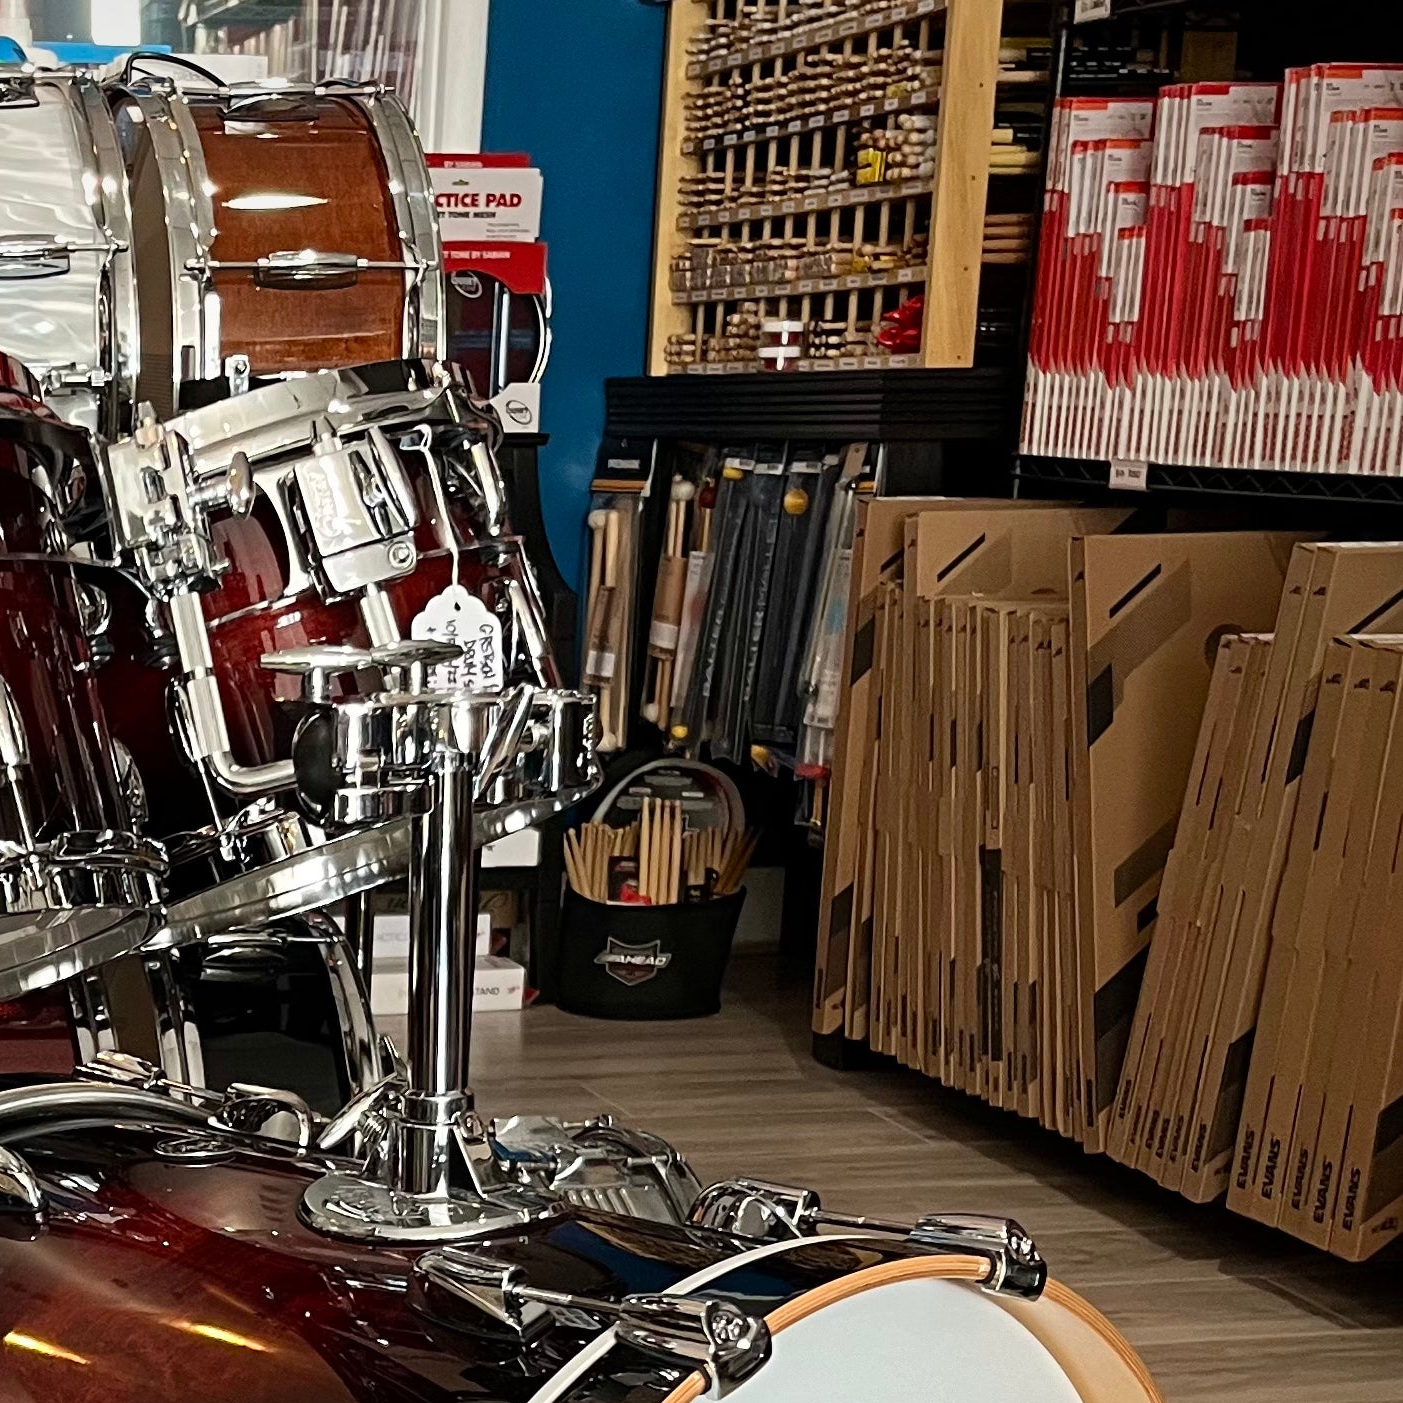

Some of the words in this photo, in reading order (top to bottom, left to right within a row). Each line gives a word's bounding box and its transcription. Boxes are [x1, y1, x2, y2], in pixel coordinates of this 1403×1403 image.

[434, 193, 479, 208] CTICE
[485, 193, 522, 208] PAD
[474, 986, 500, 997] TAND
[1236, 1130, 1255, 1190] EVANS
[1261, 1137, 1281, 1200] EVANS
[1291, 1148, 1309, 1210] EVANS
[1313, 1159, 1333, 1224] EVANS
[1342, 1167, 1361, 1232] EVANS
